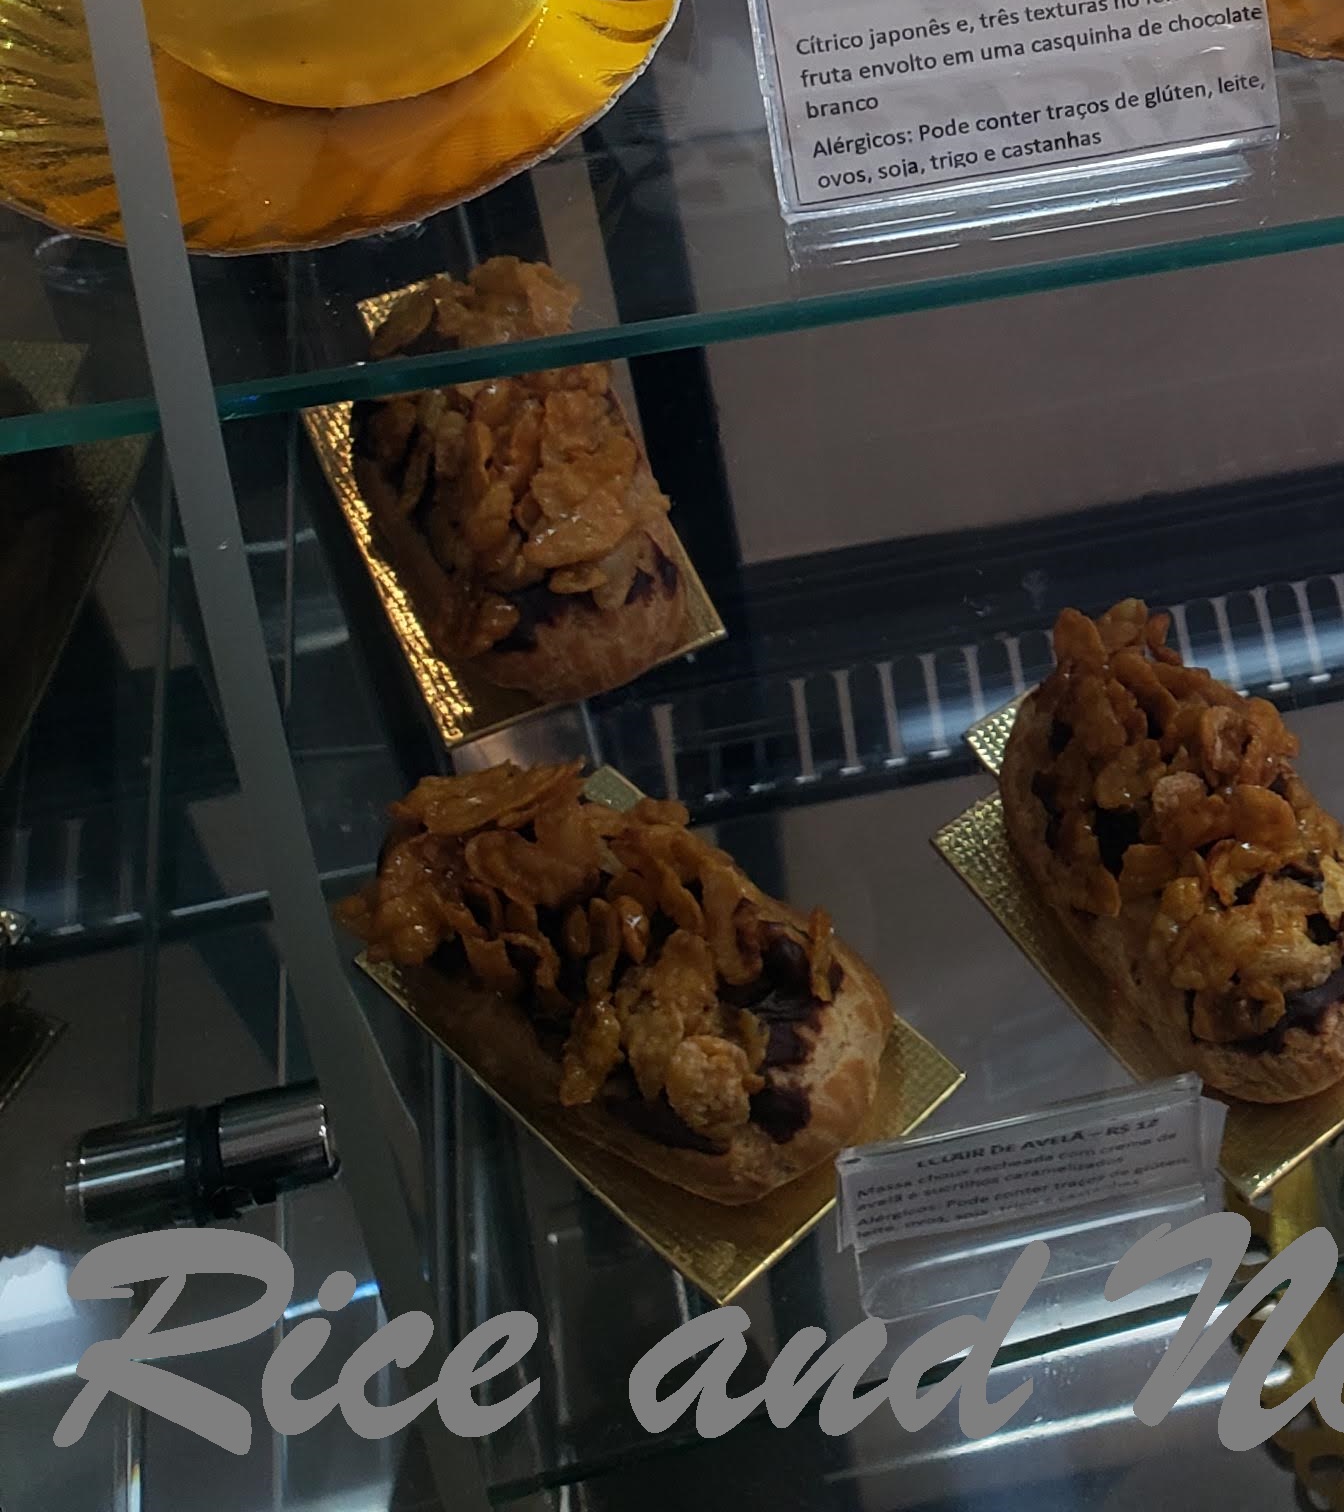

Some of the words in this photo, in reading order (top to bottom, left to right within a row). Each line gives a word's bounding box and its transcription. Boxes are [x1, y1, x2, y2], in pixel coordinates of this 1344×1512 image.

[797, 34, 863, 55] Cítrico
[869, 19, 950, 50] japonês
[957, 20, 974, 33] e,
[979, 9, 1019, 28] três
[1025, 0, 1108, 22] texturas
[800, 68, 852, 87] fruta
[860, 54, 936, 78] envolto
[943, 51, 974, 66] em
[981, 43, 1024, 60] uma
[1032, 25, 1131, 52] casquinha
[1139, 19, 1162, 36] de
[1169, 7, 1262, 32] chocolate
[806, 97, 878, 118] branco
[813, 131, 912, 158] Alérgicos:
[919, 119, 969, 141] Pode
[976, 110, 1041, 131] conter
[1046, 100, 1109, 120] traços
[1115, 92, 1139, 109] de
[1145, 85, 1212, 108] glúten,
[1218, 75, 1264, 93] leite,
[818, 170, 872, 188] ovos,
[878, 159, 925, 179] soja,
[930, 152, 977, 169] trigo
[984, 149, 995, 161] e
[1002, 131, 1101, 158] castanhas
